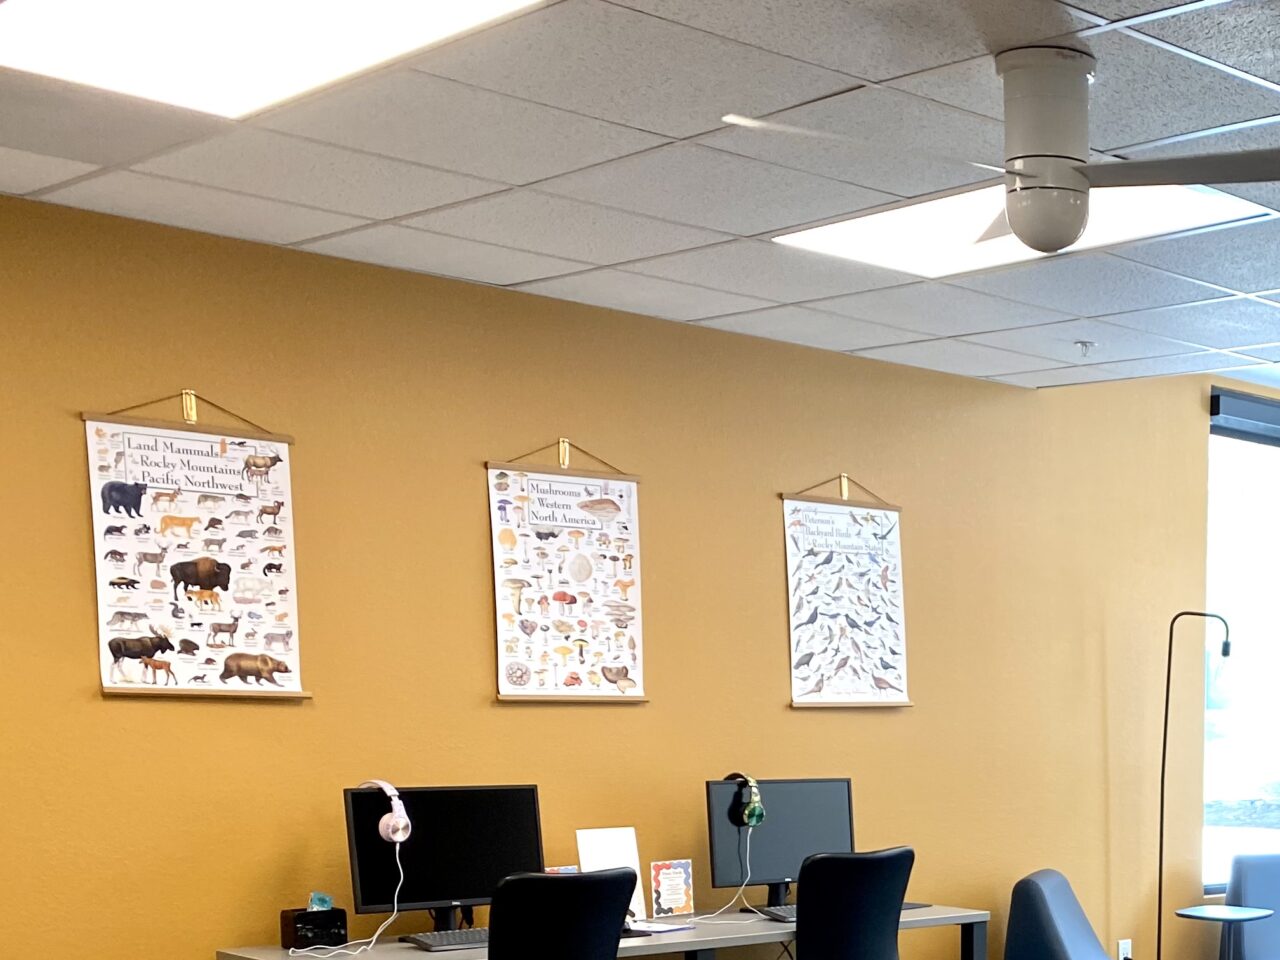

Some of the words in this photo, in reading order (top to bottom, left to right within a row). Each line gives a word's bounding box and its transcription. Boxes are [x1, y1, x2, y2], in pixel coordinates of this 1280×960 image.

[127, 437, 159, 452] Land
[162, 441, 219, 458] Mammals
[140, 454, 177, 472] Rocky
[180, 458, 242, 476] Mountains
[141, 470, 181, 486] Pacific
[184, 474, 244, 491] Northwest
[530, 482, 581, 497] Mushrooms
[537, 497, 572, 510] Western
[531, 510, 557, 522] North
[560, 513, 596, 525] America
